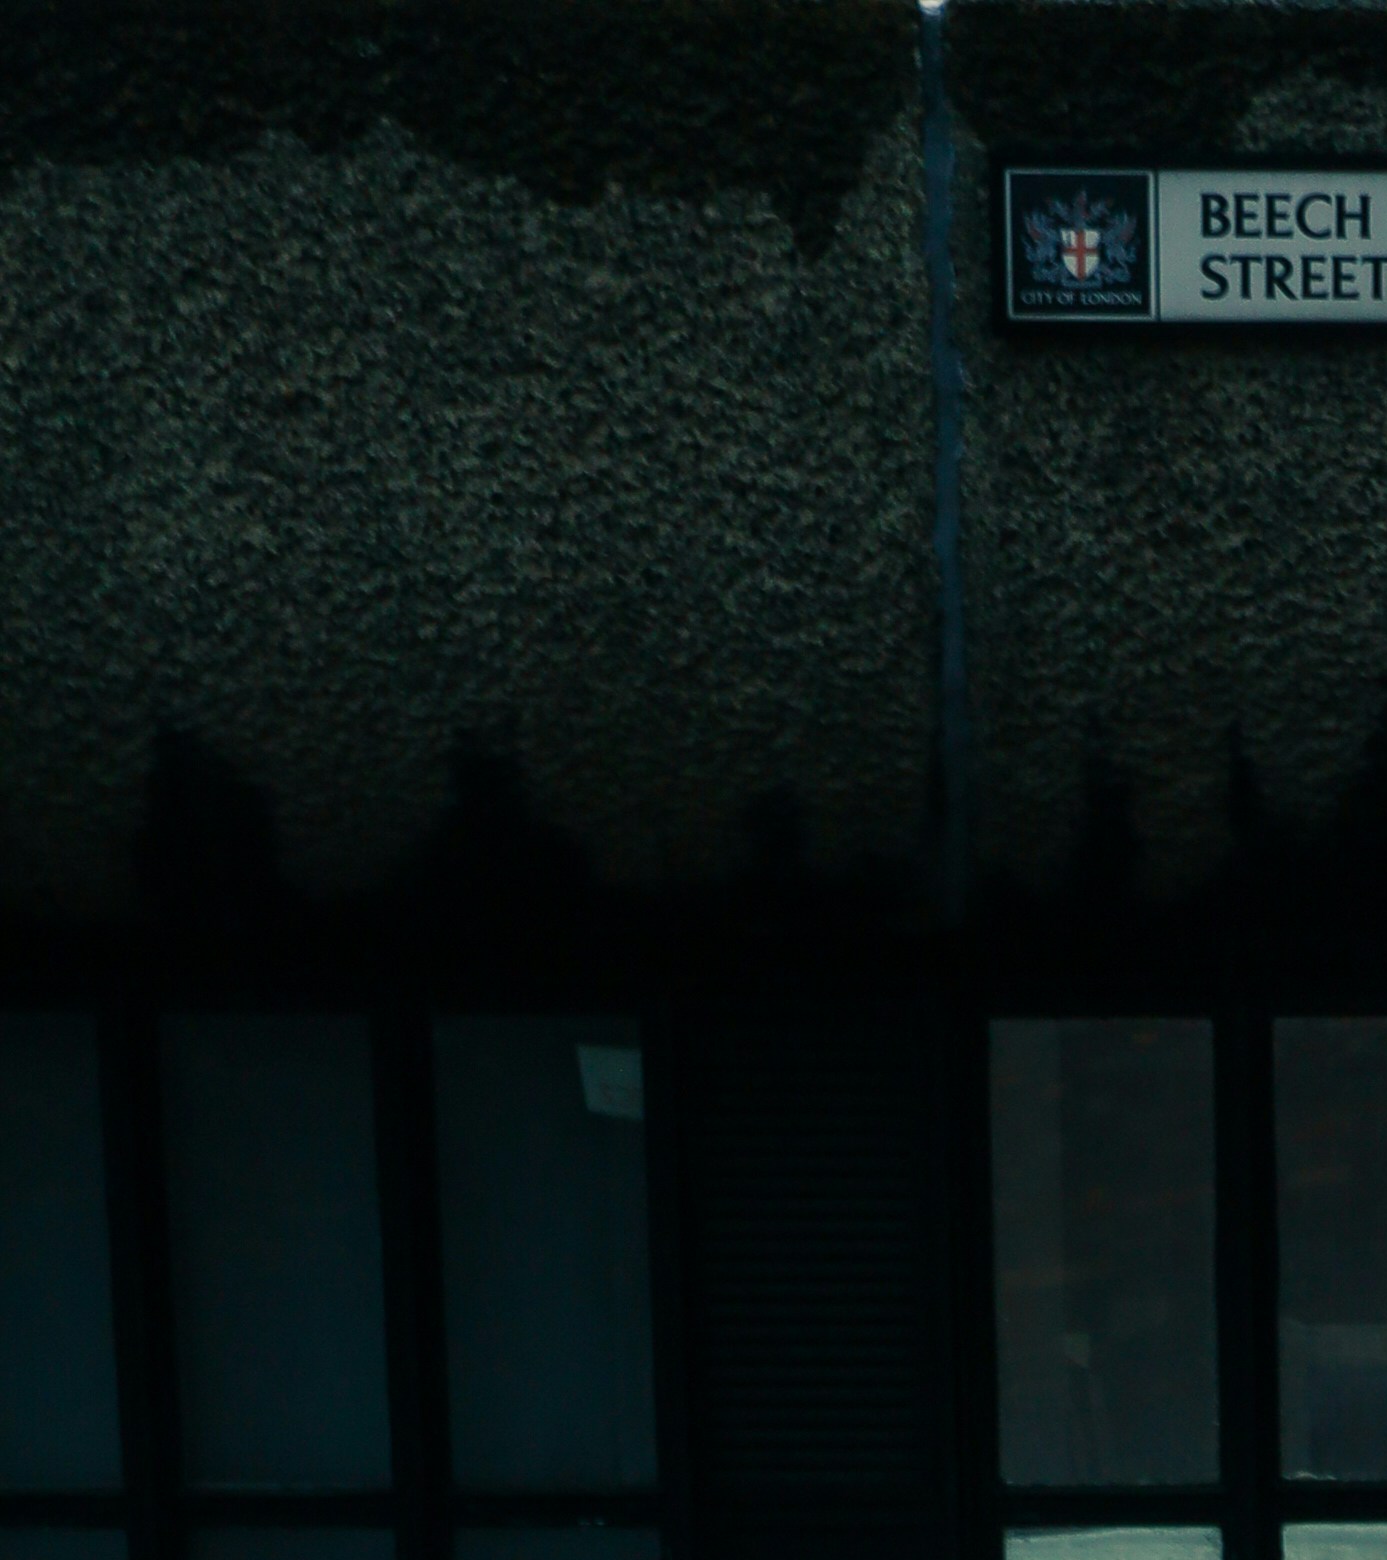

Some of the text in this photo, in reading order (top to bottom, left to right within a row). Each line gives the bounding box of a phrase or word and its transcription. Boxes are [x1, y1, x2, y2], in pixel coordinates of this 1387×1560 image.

[1200, 191, 1372, 241] BEECH
[1020, 289, 1143, 306] CITY OF LONDON
